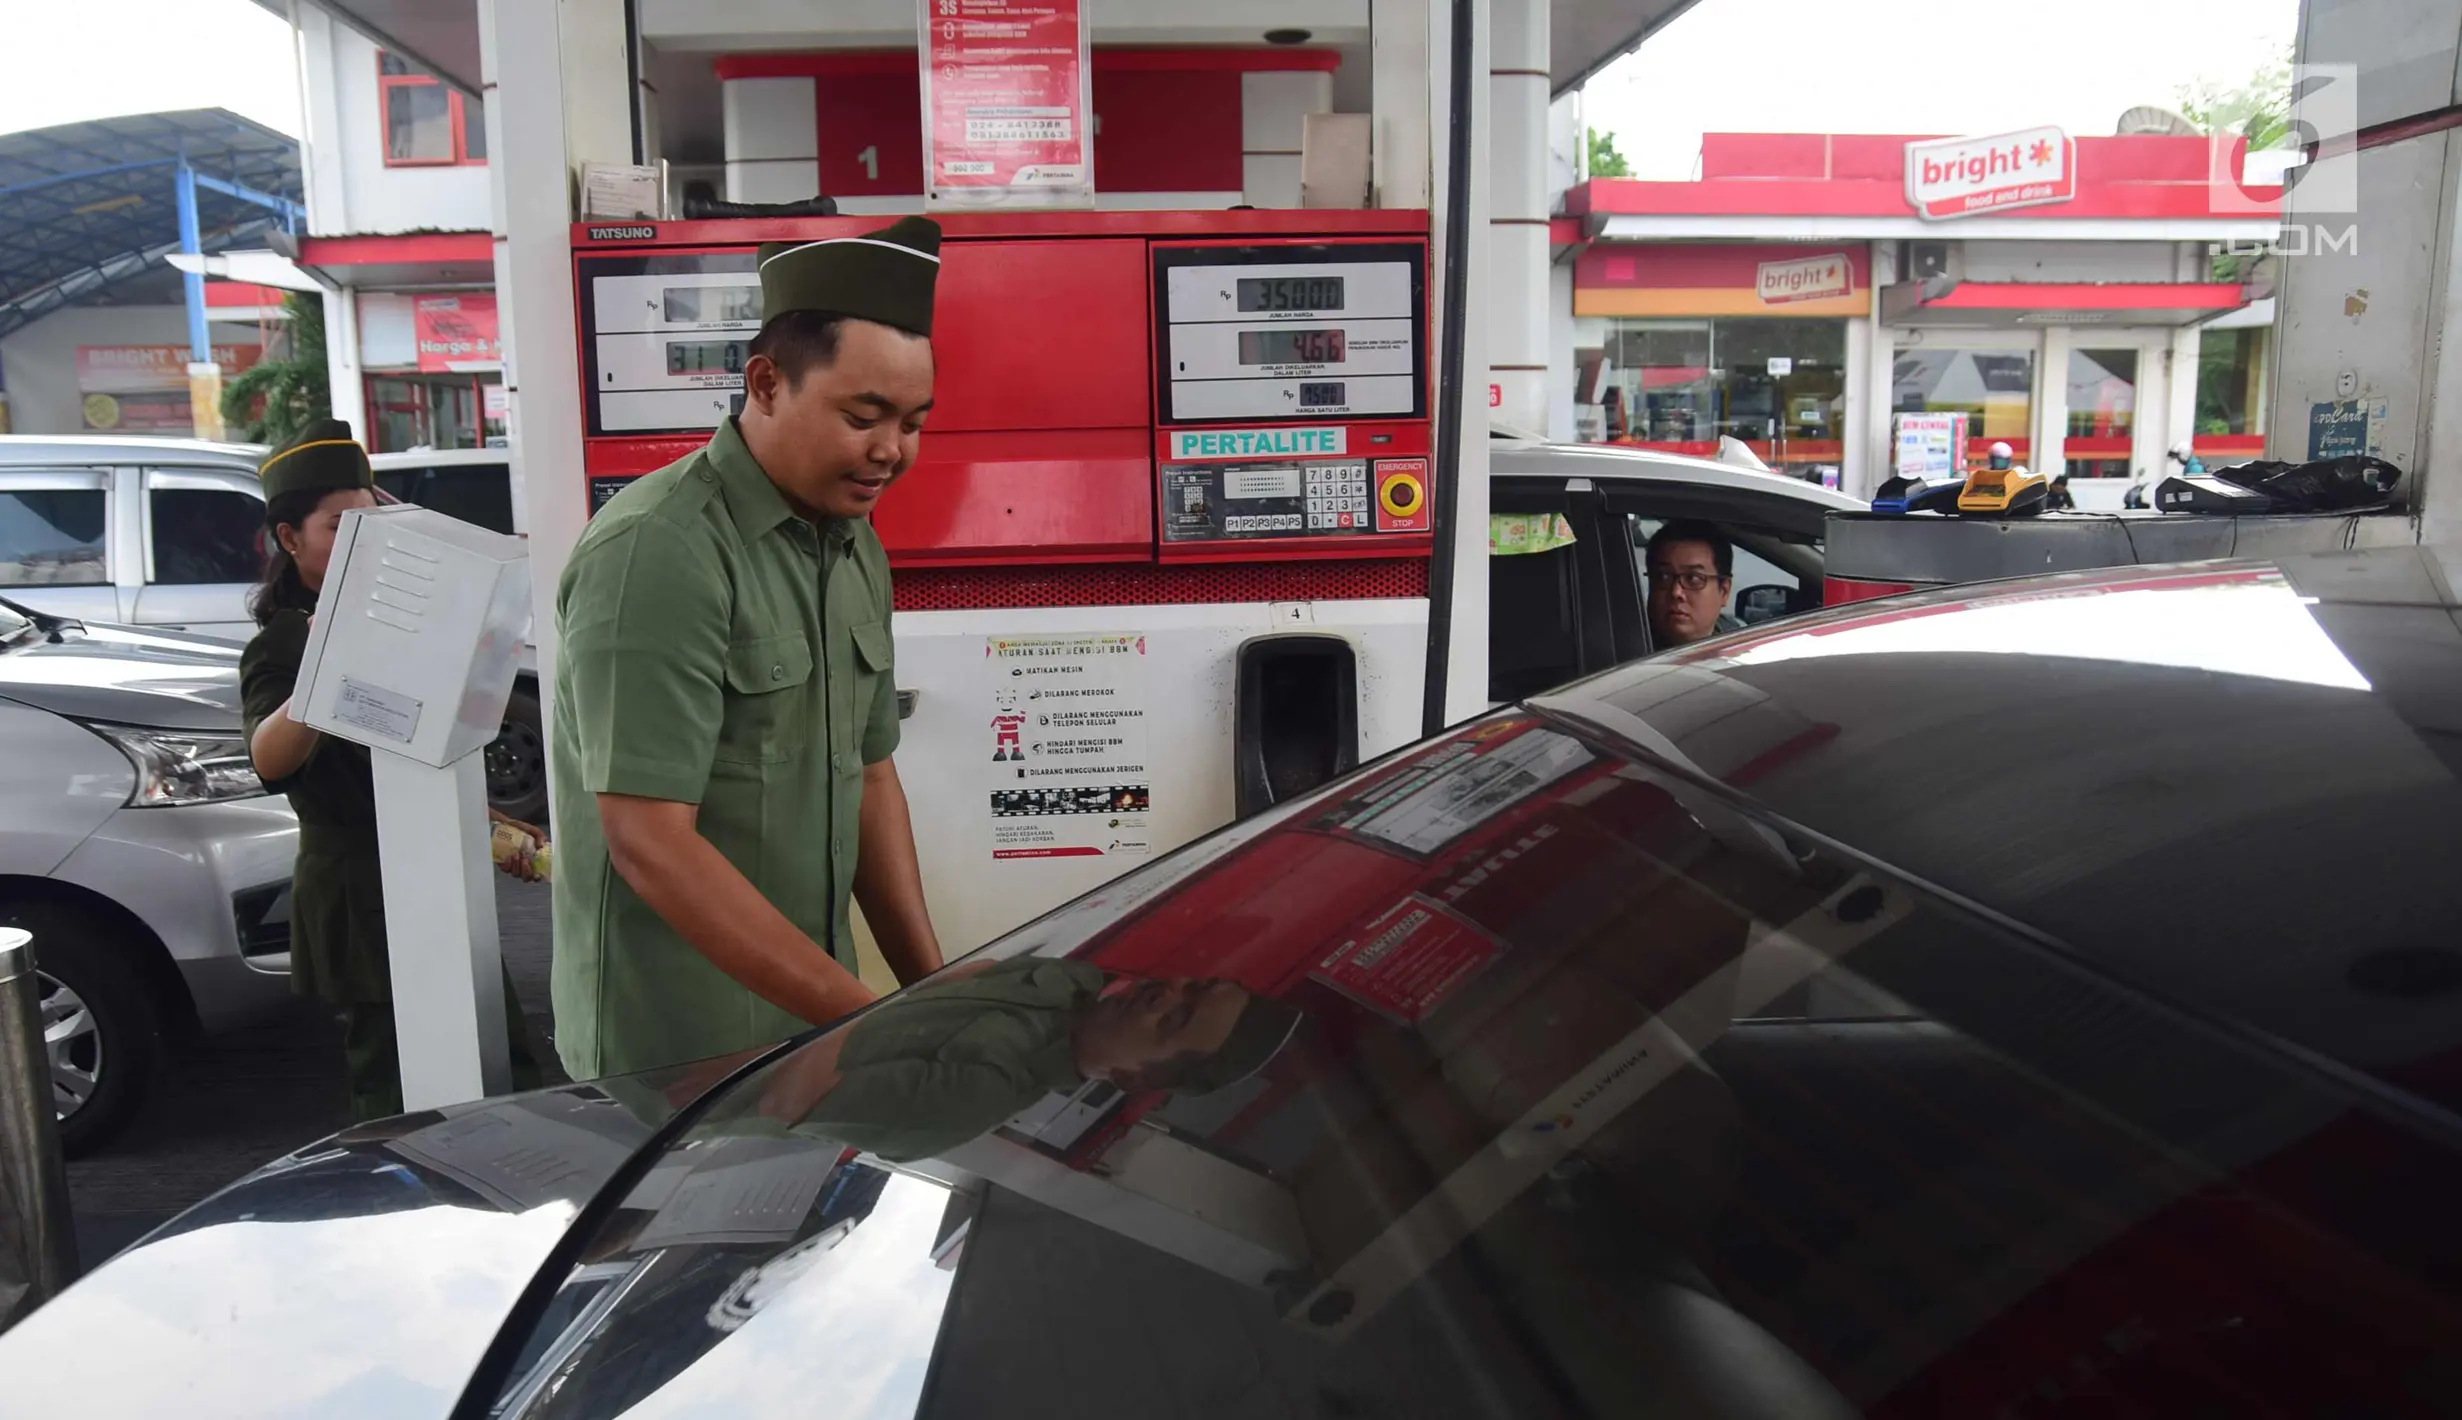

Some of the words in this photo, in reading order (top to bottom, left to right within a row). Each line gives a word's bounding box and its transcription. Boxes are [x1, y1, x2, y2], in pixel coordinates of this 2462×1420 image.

[858, 145, 878, 179] 1
[1922, 145, 2022, 185] bright
[1964, 192, 1993, 210] food
[1995, 188, 2019, 203] and
[2021, 184, 2053, 199] drink
[590, 227, 653, 240] TATSUNO
[1764, 268, 1821, 290] bright
[1220, 290, 1231, 300] Rp
[1258, 280, 1341, 310] 35000
[647, 300, 658, 311] Rp
[420, 340, 471, 355] Harga
[89, 348, 167, 364] BRIGHT
[174, 348, 236, 363] WSH
[1283, 390, 1294, 400] Rp
[713, 401, 725, 411] Rp
[1182, 431, 1335, 456] PERTALITE
[1378, 463, 1422, 471] EMERGENCY
[1310, 470, 1316, 480] 7
[1325, 470, 1332, 479] 8
[1340, 470, 1347, 479] 9
[1310, 486, 1317, 495] 4
[1326, 486, 1333, 495] 5
[1340, 485, 1348, 494] 6
[1326, 501, 1333, 510] 2
[1341, 500, 1348, 509] 3
[1228, 519, 1238, 527] P1
[1243, 519, 1255, 527] P2
[1257, 518, 1270, 527] P3
[1273, 518, 1285, 526] P4
[1288, 518, 1300, 526] P5
[1312, 516, 1318, 525] 0
[1341, 515, 1349, 524] C
[1357, 515, 1364, 524] L
[1291, 607, 1300, 619] 4
[998, 649, 1034, 657] ATURAN
[1038, 647, 1061, 655] SAAT
[1110, 645, 1128, 653] BBM
[1026, 667, 1058, 675] MATIKAN
[1045, 690, 1079, 698] DILARANG
[1052, 712, 1088, 720] DILARANG
[1090, 710, 1143, 718] MENGGUNAKAN
[1078, 739, 1107, 747] MENGISI
[1047, 747, 1074, 755] HINGGA
[1030, 768, 1063, 776] DILARANG
[1065, 767, 1115, 775] MENGGUNAKAN
[1116, 765, 1144, 773] JERIGEN
